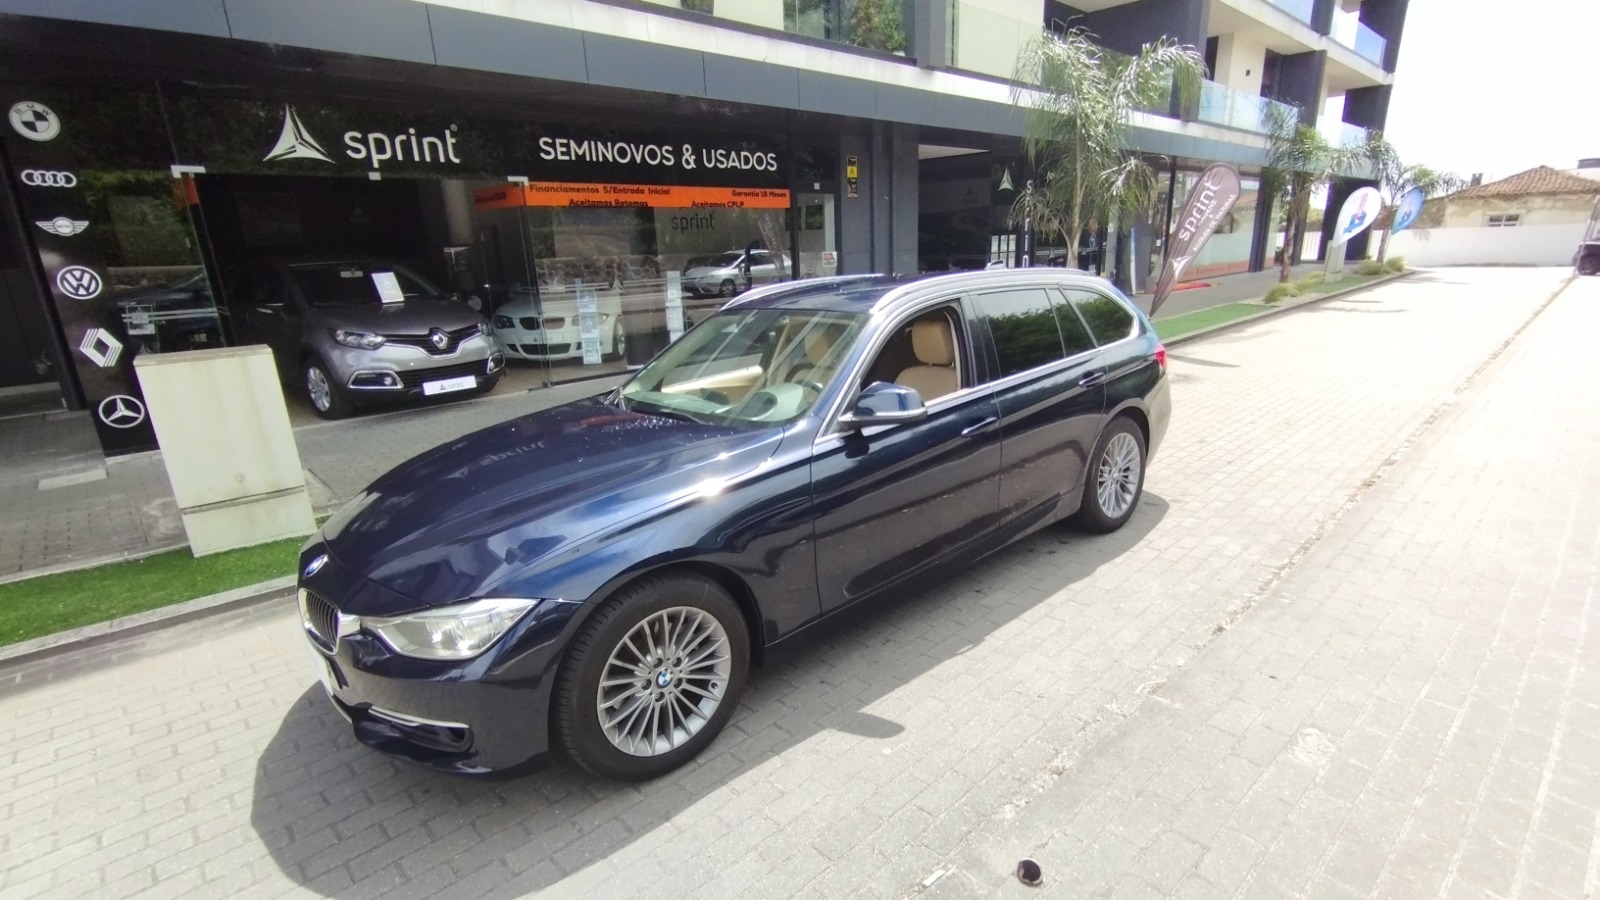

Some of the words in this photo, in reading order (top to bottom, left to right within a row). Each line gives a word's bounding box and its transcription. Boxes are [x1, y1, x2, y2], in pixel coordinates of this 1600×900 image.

[344, 127, 460, 168] sprint
[538, 136, 675, 167] SEMINOVOS
[681, 143, 697, 170] &
[703, 148, 778, 172] USADOS
[529, 184, 600, 194] Financiamentos
[648, 187, 671, 196] Inicial
[731, 189, 760, 198] Garantia
[760, 190, 768, 198] 18
[768, 190, 787, 198] Meses
[569, 198, 613, 208] Aceitamos
[614, 198, 649, 208] Retomas
[691, 200, 726, 208] Aceitamos
[1178, 180, 1221, 242] sprint
[671, 212, 715, 234] sprint
